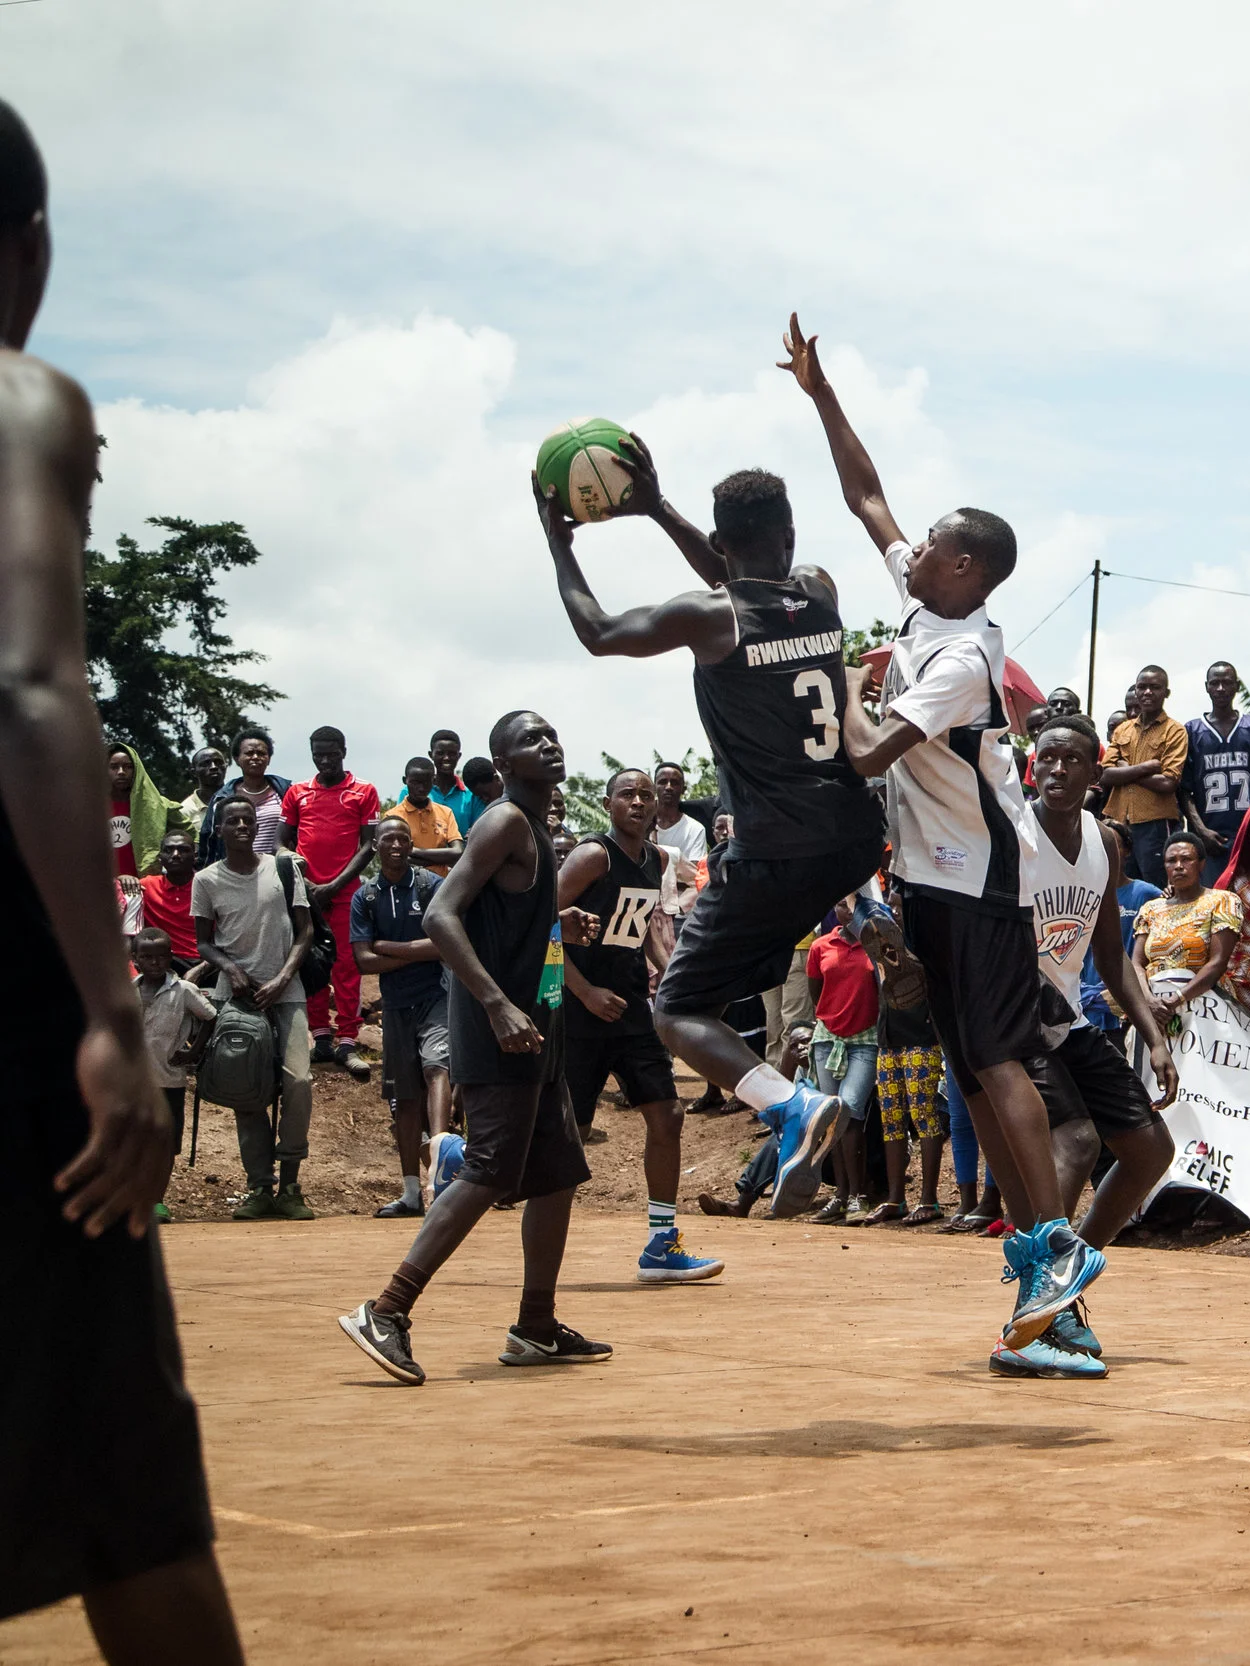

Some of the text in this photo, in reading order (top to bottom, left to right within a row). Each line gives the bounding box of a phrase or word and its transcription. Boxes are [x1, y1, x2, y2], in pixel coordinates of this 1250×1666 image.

[793, 669, 840, 761] 3
[1203, 751, 1248, 770] NOBLES
[114, 834, 123, 843] 2
[1034, 886, 1101, 922] THUNDER
